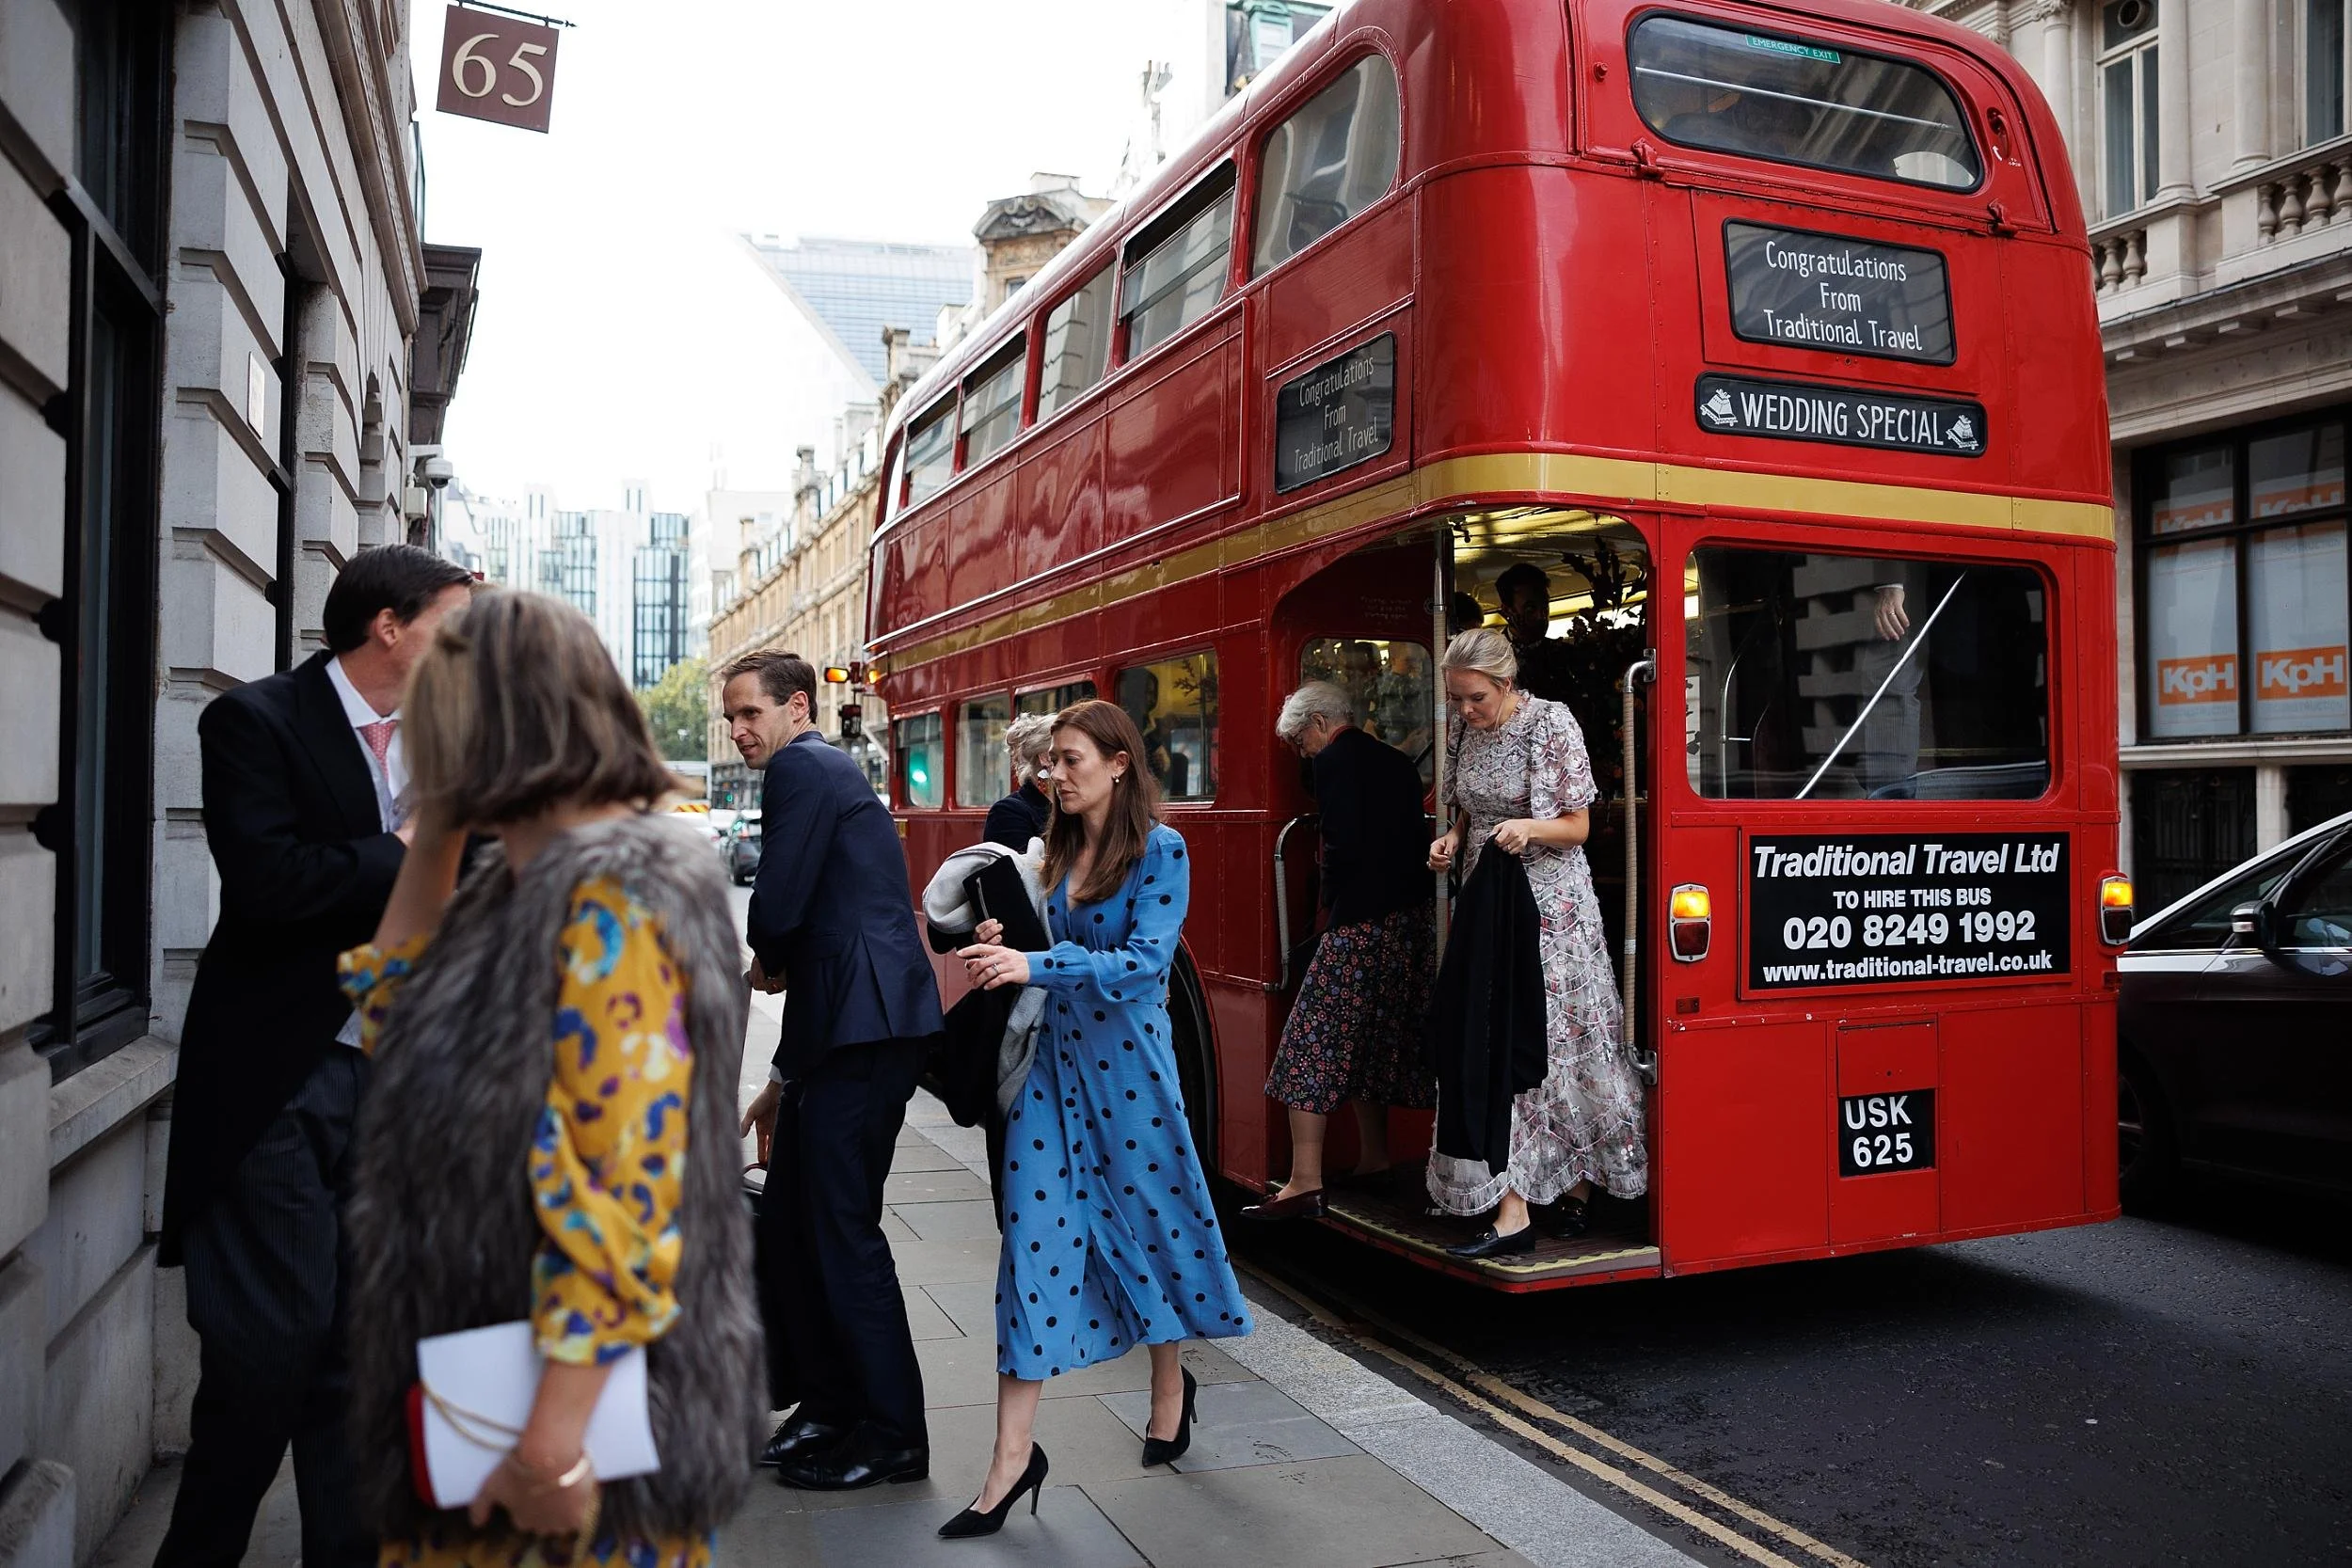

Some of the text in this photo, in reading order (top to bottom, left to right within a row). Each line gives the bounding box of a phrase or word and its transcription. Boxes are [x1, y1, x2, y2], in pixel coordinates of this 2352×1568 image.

[1753, 38, 1833, 59] EMERGENCY EXIT
[452, 33, 548, 107] 65
[1765, 240, 1907, 282] Congratulations
[1820, 282, 1862, 312] From
[1763, 309, 1923, 351] Traditional Travel
[1299, 356, 1375, 407] Congratulations
[1324, 404, 1346, 431] From
[1740, 391, 1944, 446] WEDDING SPECIAL
[1295, 416, 1379, 474] Traditional Travel
[2163, 662, 2235, 699] KpH
[2262, 655, 2344, 693] KpH
[1754, 843, 2060, 879] Traditional Travel Ltd
[1833, 887, 1992, 910] TO HIRE THIS BUS
[1783, 911, 2036, 950] 020 8249 1992
[1762, 949, 2053, 982] www.traditional-travel.co.uk
[1844, 1095, 1913, 1130] USK
[1852, 1132, 1914, 1167] 625
